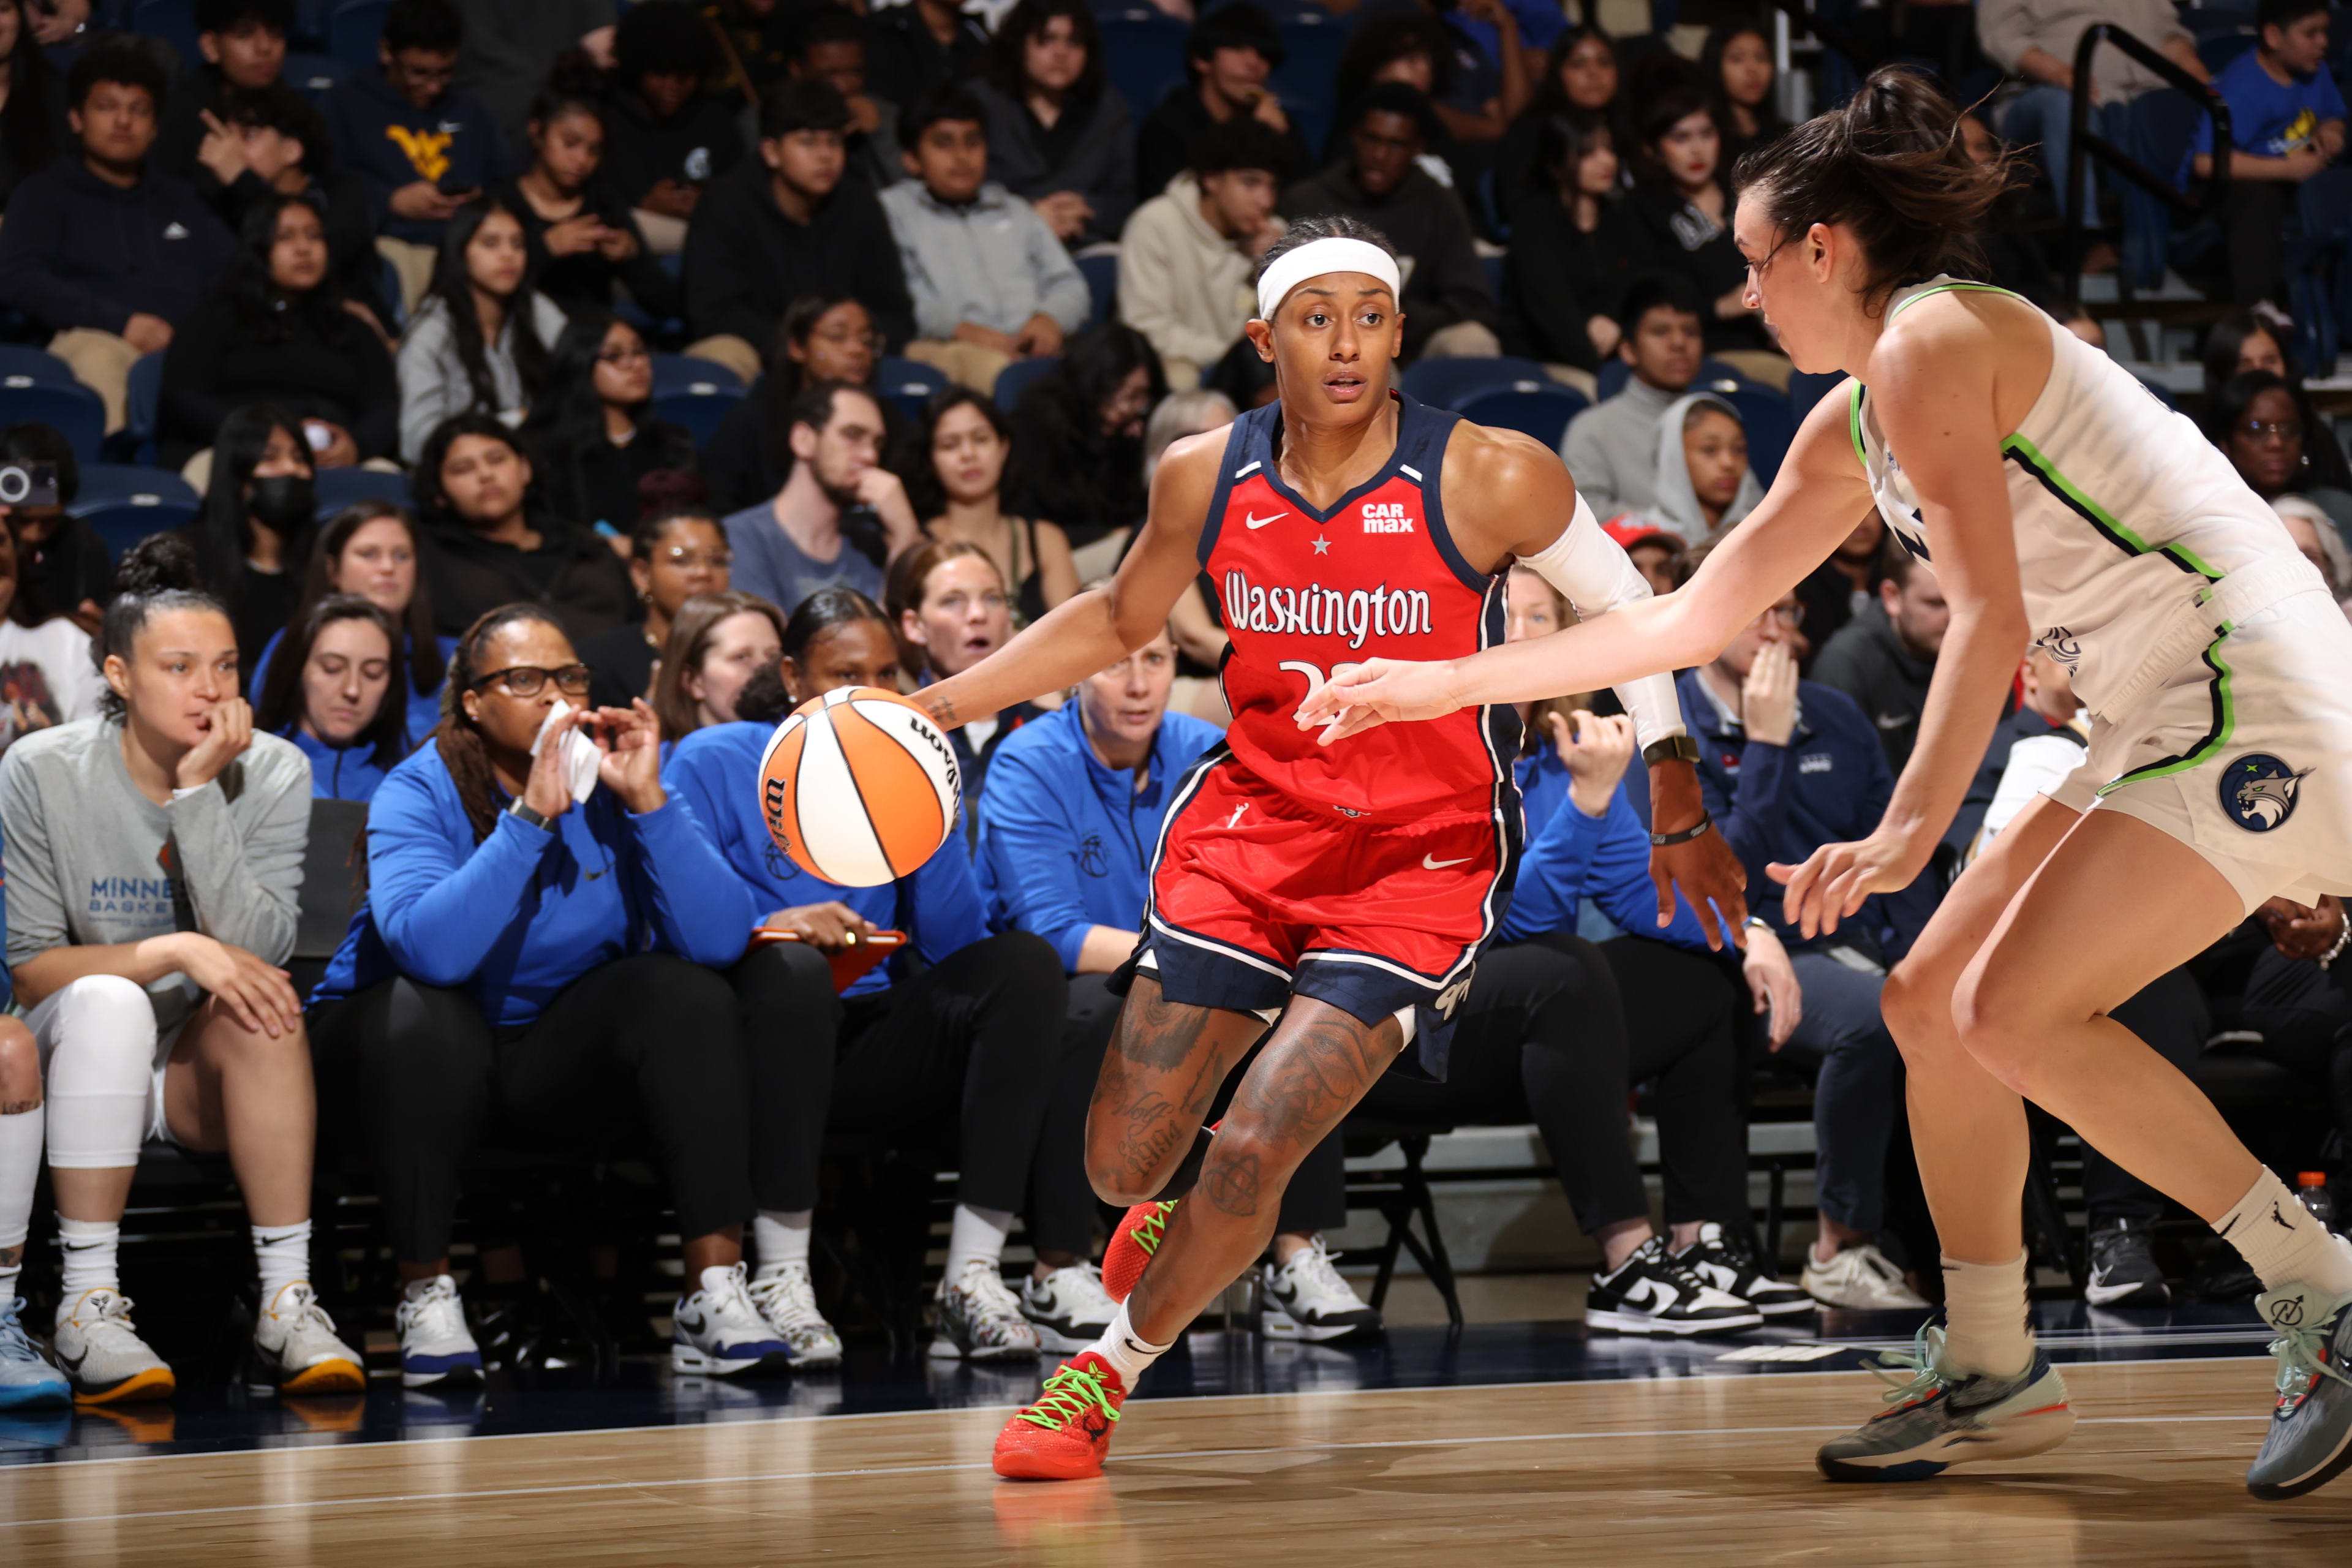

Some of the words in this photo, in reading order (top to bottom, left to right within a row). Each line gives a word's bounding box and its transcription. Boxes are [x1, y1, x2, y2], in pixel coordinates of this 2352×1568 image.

[1362, 503, 1404, 518] CAR
[1363, 518, 1414, 533] max
[1278, 660, 1363, 726] 2
[89, 899, 172, 914] BASKE
